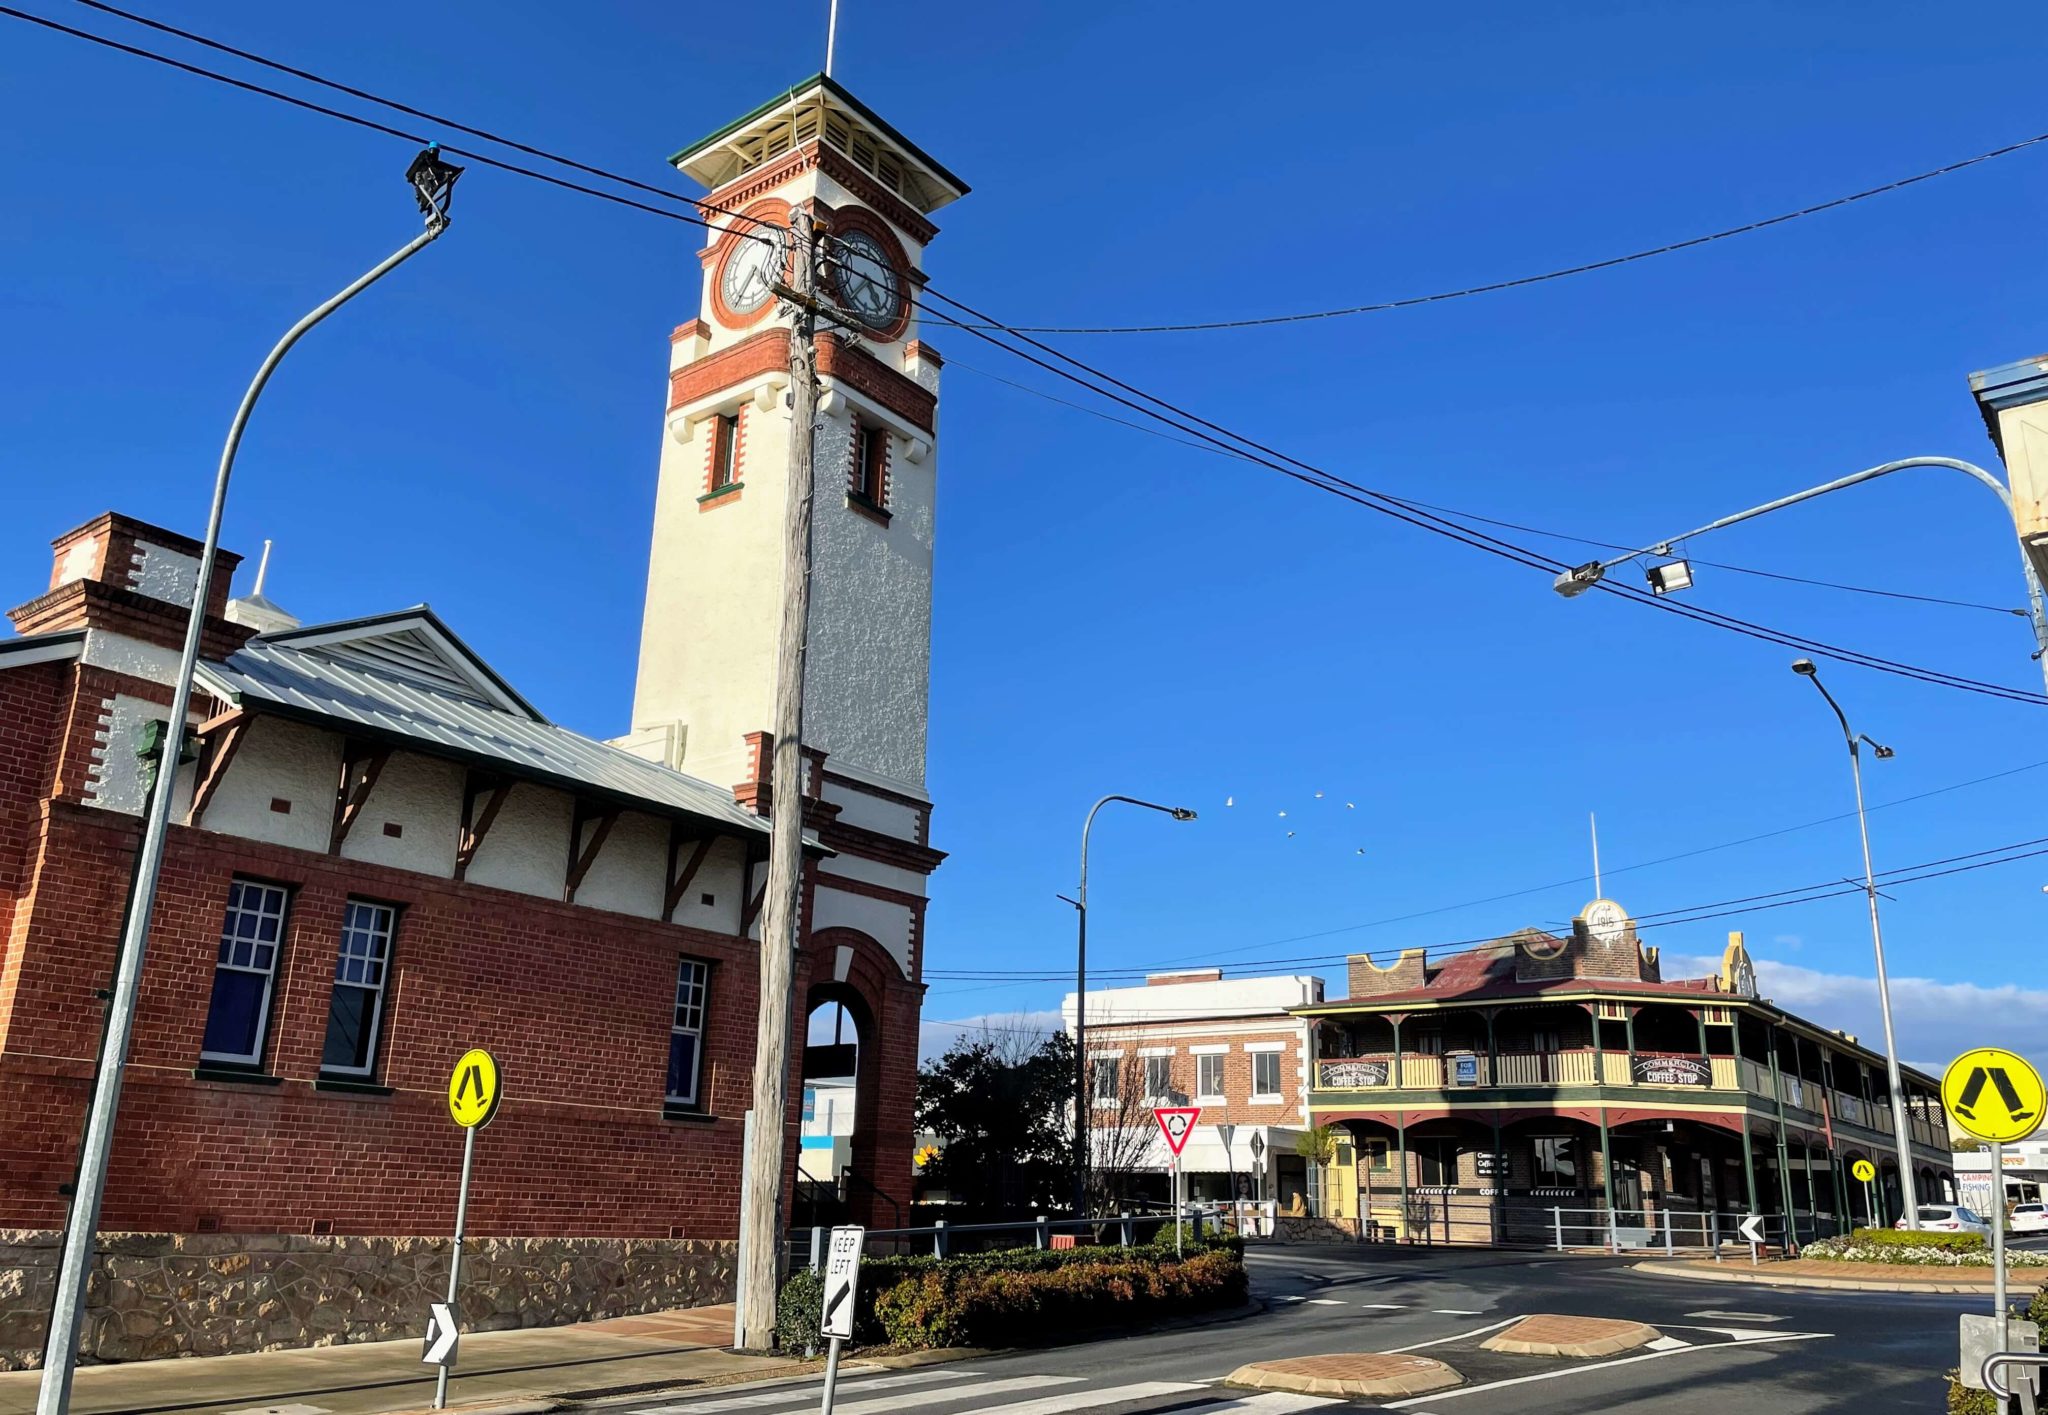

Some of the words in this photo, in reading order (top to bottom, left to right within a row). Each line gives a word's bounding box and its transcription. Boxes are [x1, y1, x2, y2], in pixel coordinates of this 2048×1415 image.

[1597, 917, 1615, 928] 1915
[1328, 1063, 1379, 1075] COMMERCIAL
[1643, 1059, 1700, 1071] COMMERCIAL
[1332, 1076, 1356, 1086] COFFEE
[1359, 1075, 1377, 1086] STOP
[1647, 1072, 1674, 1083] COFFEE
[1678, 1073, 1698, 1084] STOP
[1480, 1188, 1509, 1196] COFFE
[1963, 1183, 1990, 1191] FISHING
[833, 1237, 856, 1252] KEEP
[830, 1259, 851, 1275] LEFT
